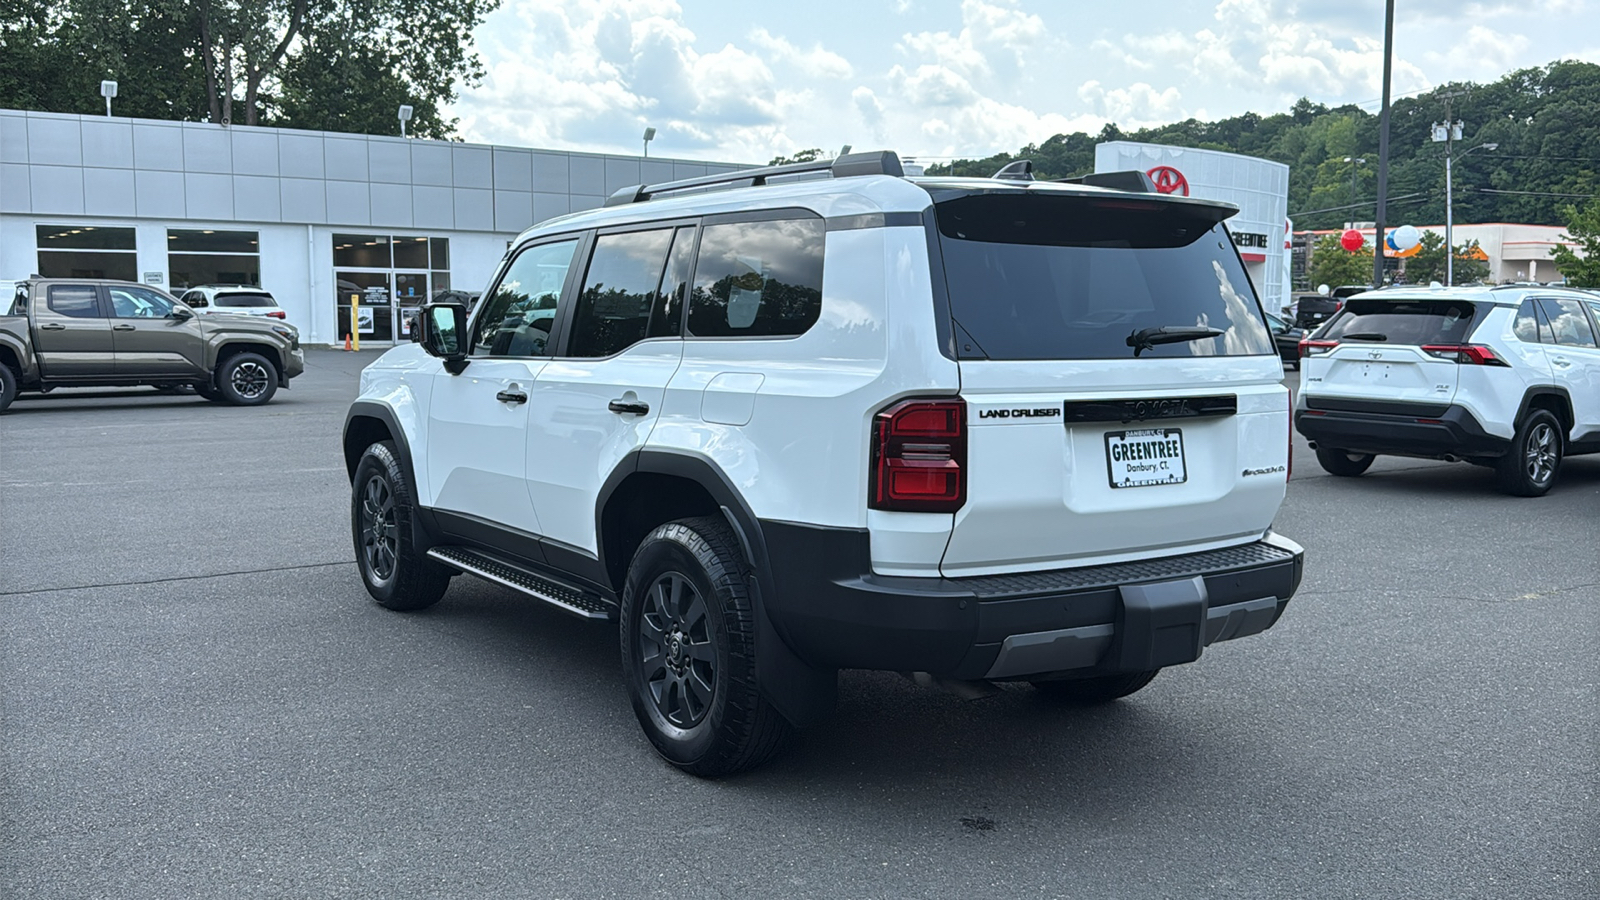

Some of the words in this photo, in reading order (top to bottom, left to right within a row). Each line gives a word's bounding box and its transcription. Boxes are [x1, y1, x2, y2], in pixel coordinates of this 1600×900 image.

[979, 409, 1010, 418] LAND
[1011, 408, 1061, 418] CRUISER
[1123, 399, 1190, 419] TOYOTA
[1112, 440, 1179, 462] GREENTREE
[1126, 462, 1158, 473] Danbury,
